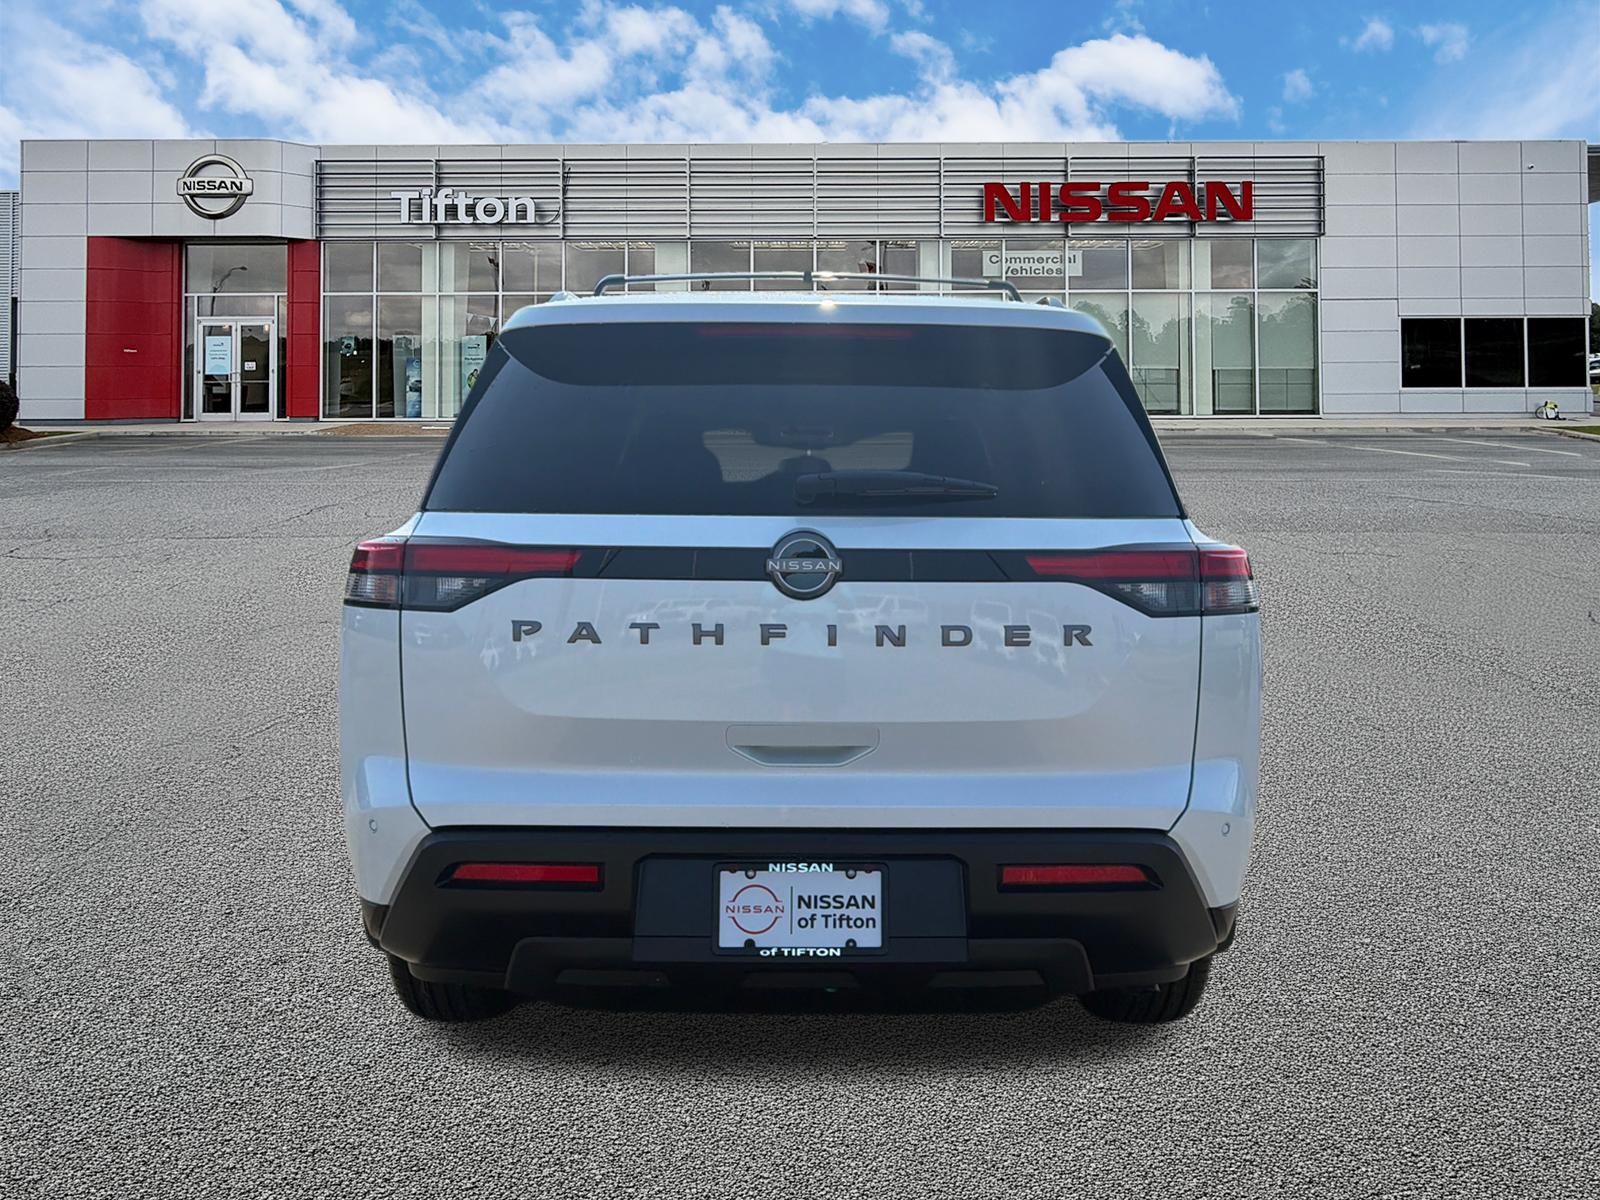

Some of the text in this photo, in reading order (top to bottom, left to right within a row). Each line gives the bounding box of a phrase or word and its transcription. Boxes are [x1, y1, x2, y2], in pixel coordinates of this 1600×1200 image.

[183, 180, 243, 192] NISSAN
[390, 188, 536, 224] Tifton
[983, 181, 1253, 223] NISSAN
[768, 560, 840, 571] NISSAN
[511, 619, 1094, 648] PATHFINDER
[768, 862, 834, 873] NISSAN
[797, 895, 876, 910] NISSAN
[725, 905, 785, 914] NISSAN
[797, 913, 876, 929] of Tifton
[759, 947, 841, 957] of TIFTON
